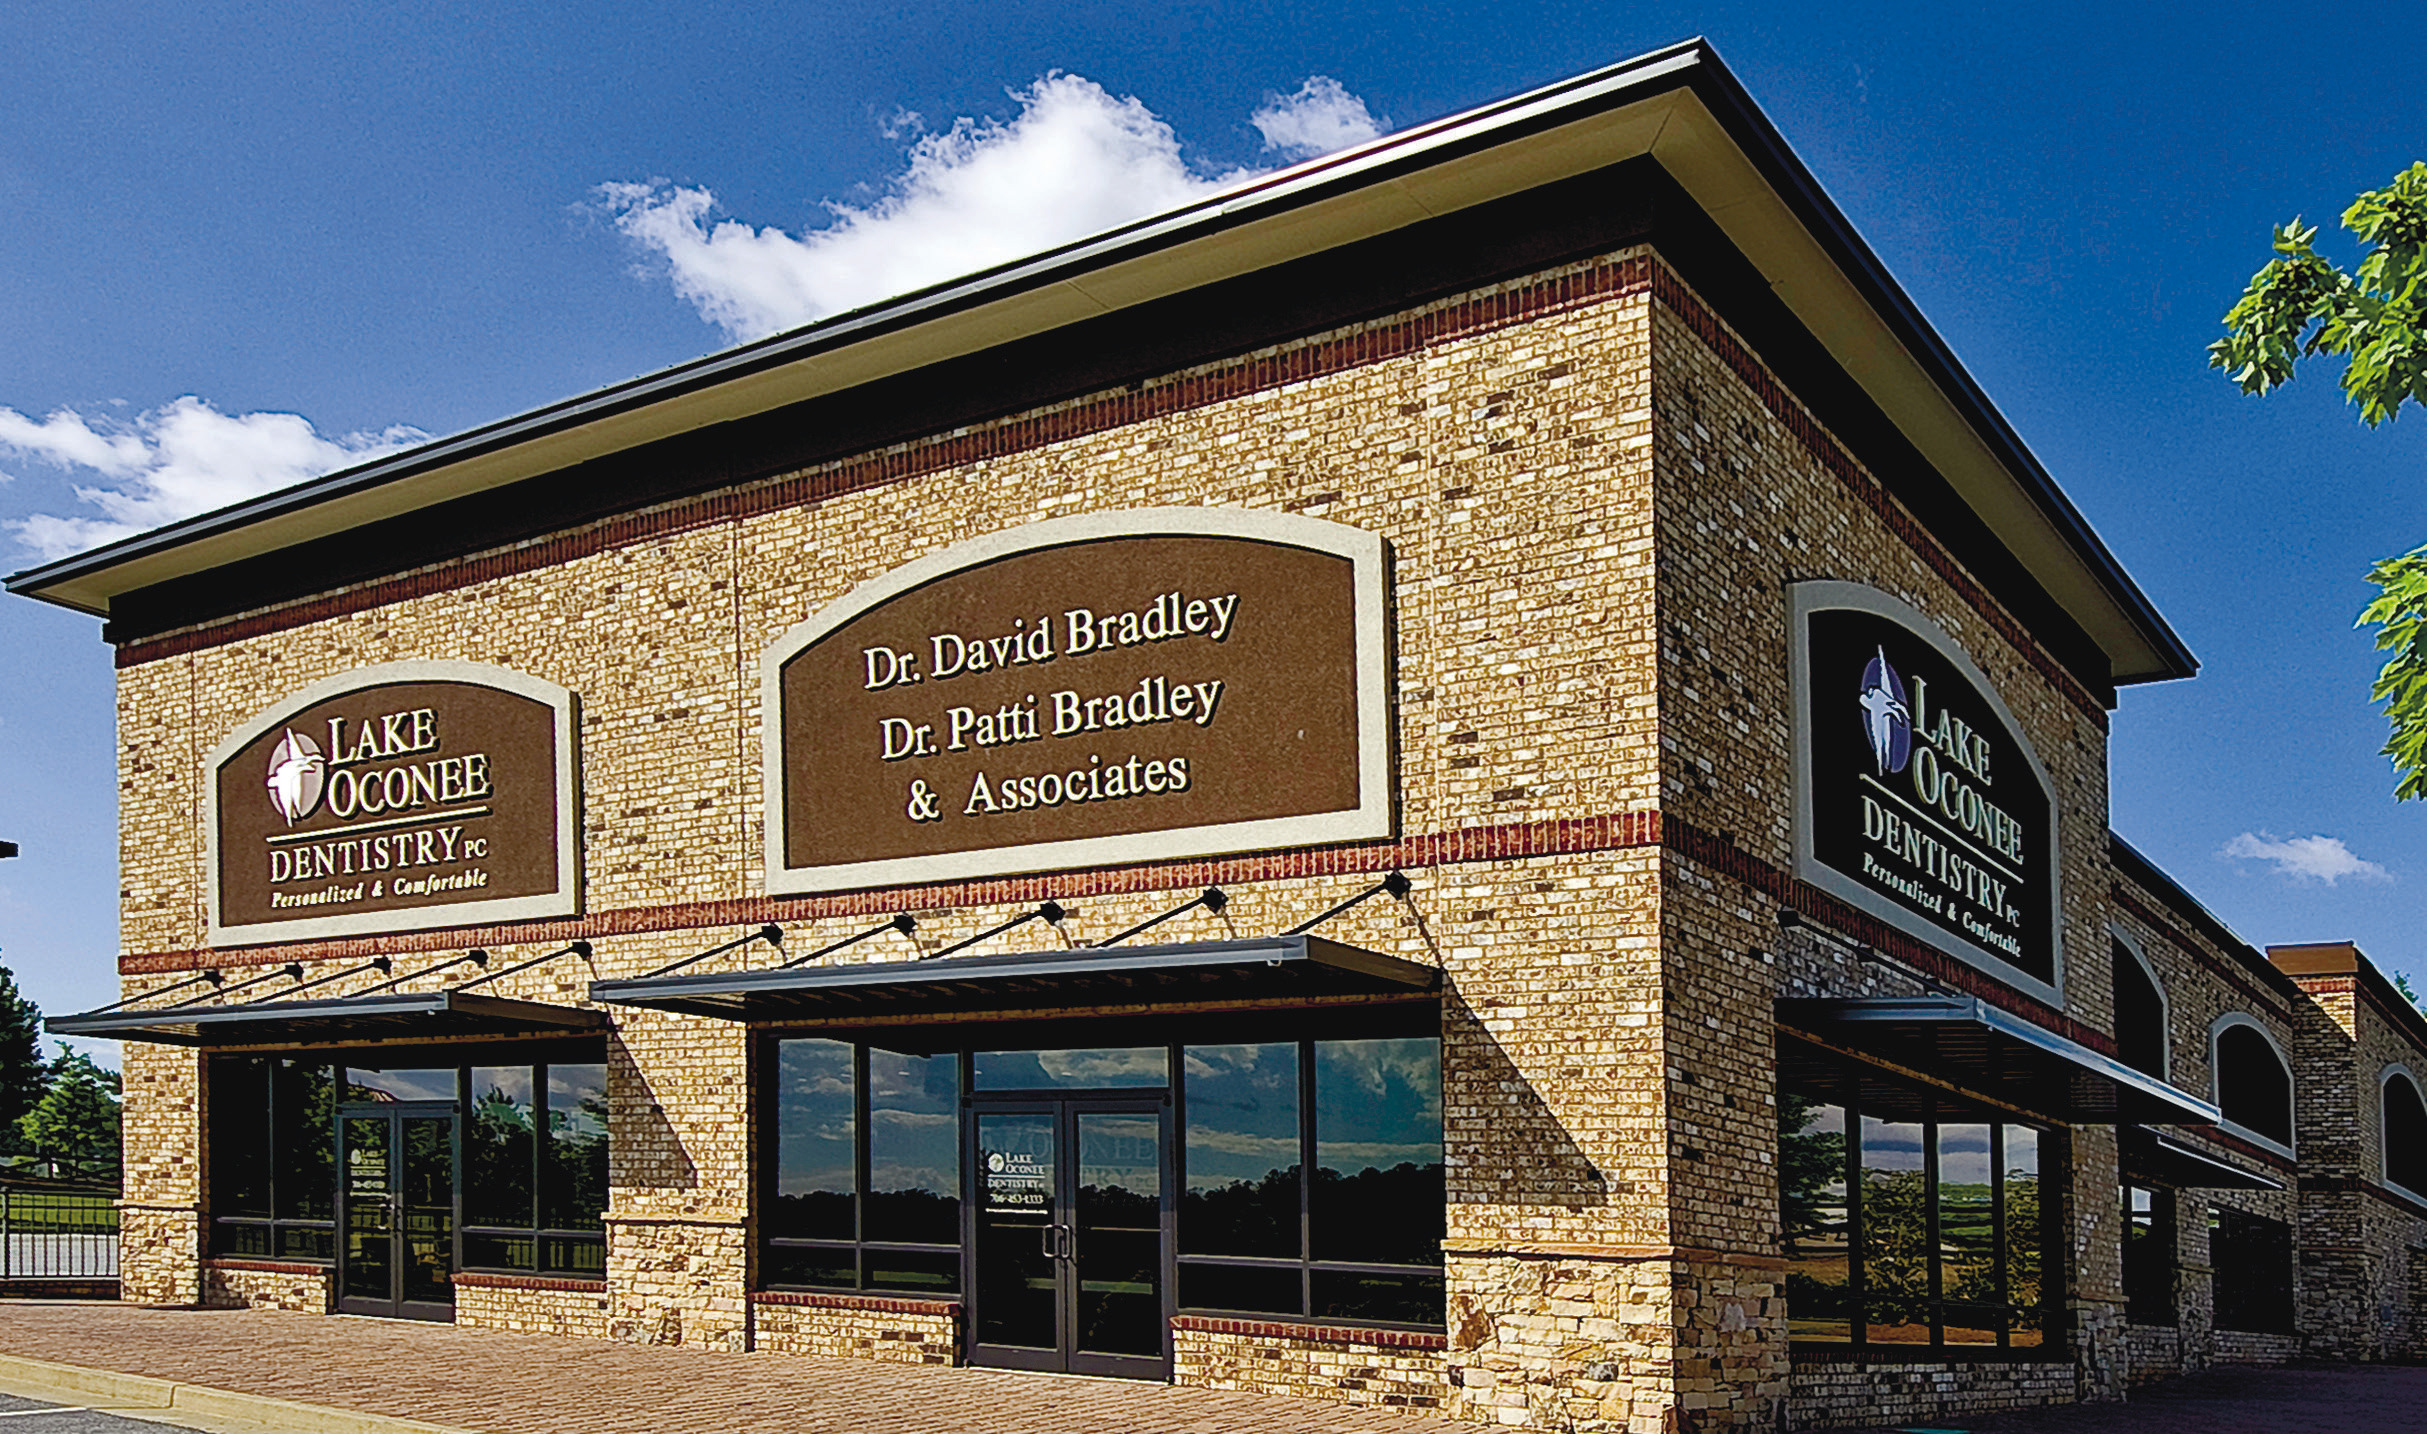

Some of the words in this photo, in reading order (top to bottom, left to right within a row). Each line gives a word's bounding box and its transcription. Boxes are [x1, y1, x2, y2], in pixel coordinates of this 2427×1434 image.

[863, 646, 922, 689] Dr.
[929, 617, 1053, 677] David
[1064, 592, 1238, 656] Bradley
[328, 708, 438, 766] LAKE
[880, 717, 938, 760] Dr.
[946, 694, 1039, 750] Patti
[1051, 674, 1222, 735] Bradley
[1912, 675, 1991, 786] LAKE
[328, 753, 491, 819] OCONEE
[907, 780, 940, 820] &
[963, 755, 1188, 814] Associates
[1912, 745, 2024, 865] OCONEE
[269, 826, 463, 883] DENTISTRY
[464, 838, 488, 858] PC
[1861, 795, 2008, 918] DENTISTRY
[271, 882, 364, 908] Personalized
[371, 880, 383, 897] &
[394, 867, 488, 895] Comfortable
[1862, 851, 1942, 914] Personalized
[1947, 902, 1957, 922] &
[1962, 911, 2021, 957] Comfortable
[987, 1179, 1039, 1188] DENTISTRY
[1005, 1152, 1033, 1163] LAKE
[1005, 1164, 1045, 1174] OCONEE
